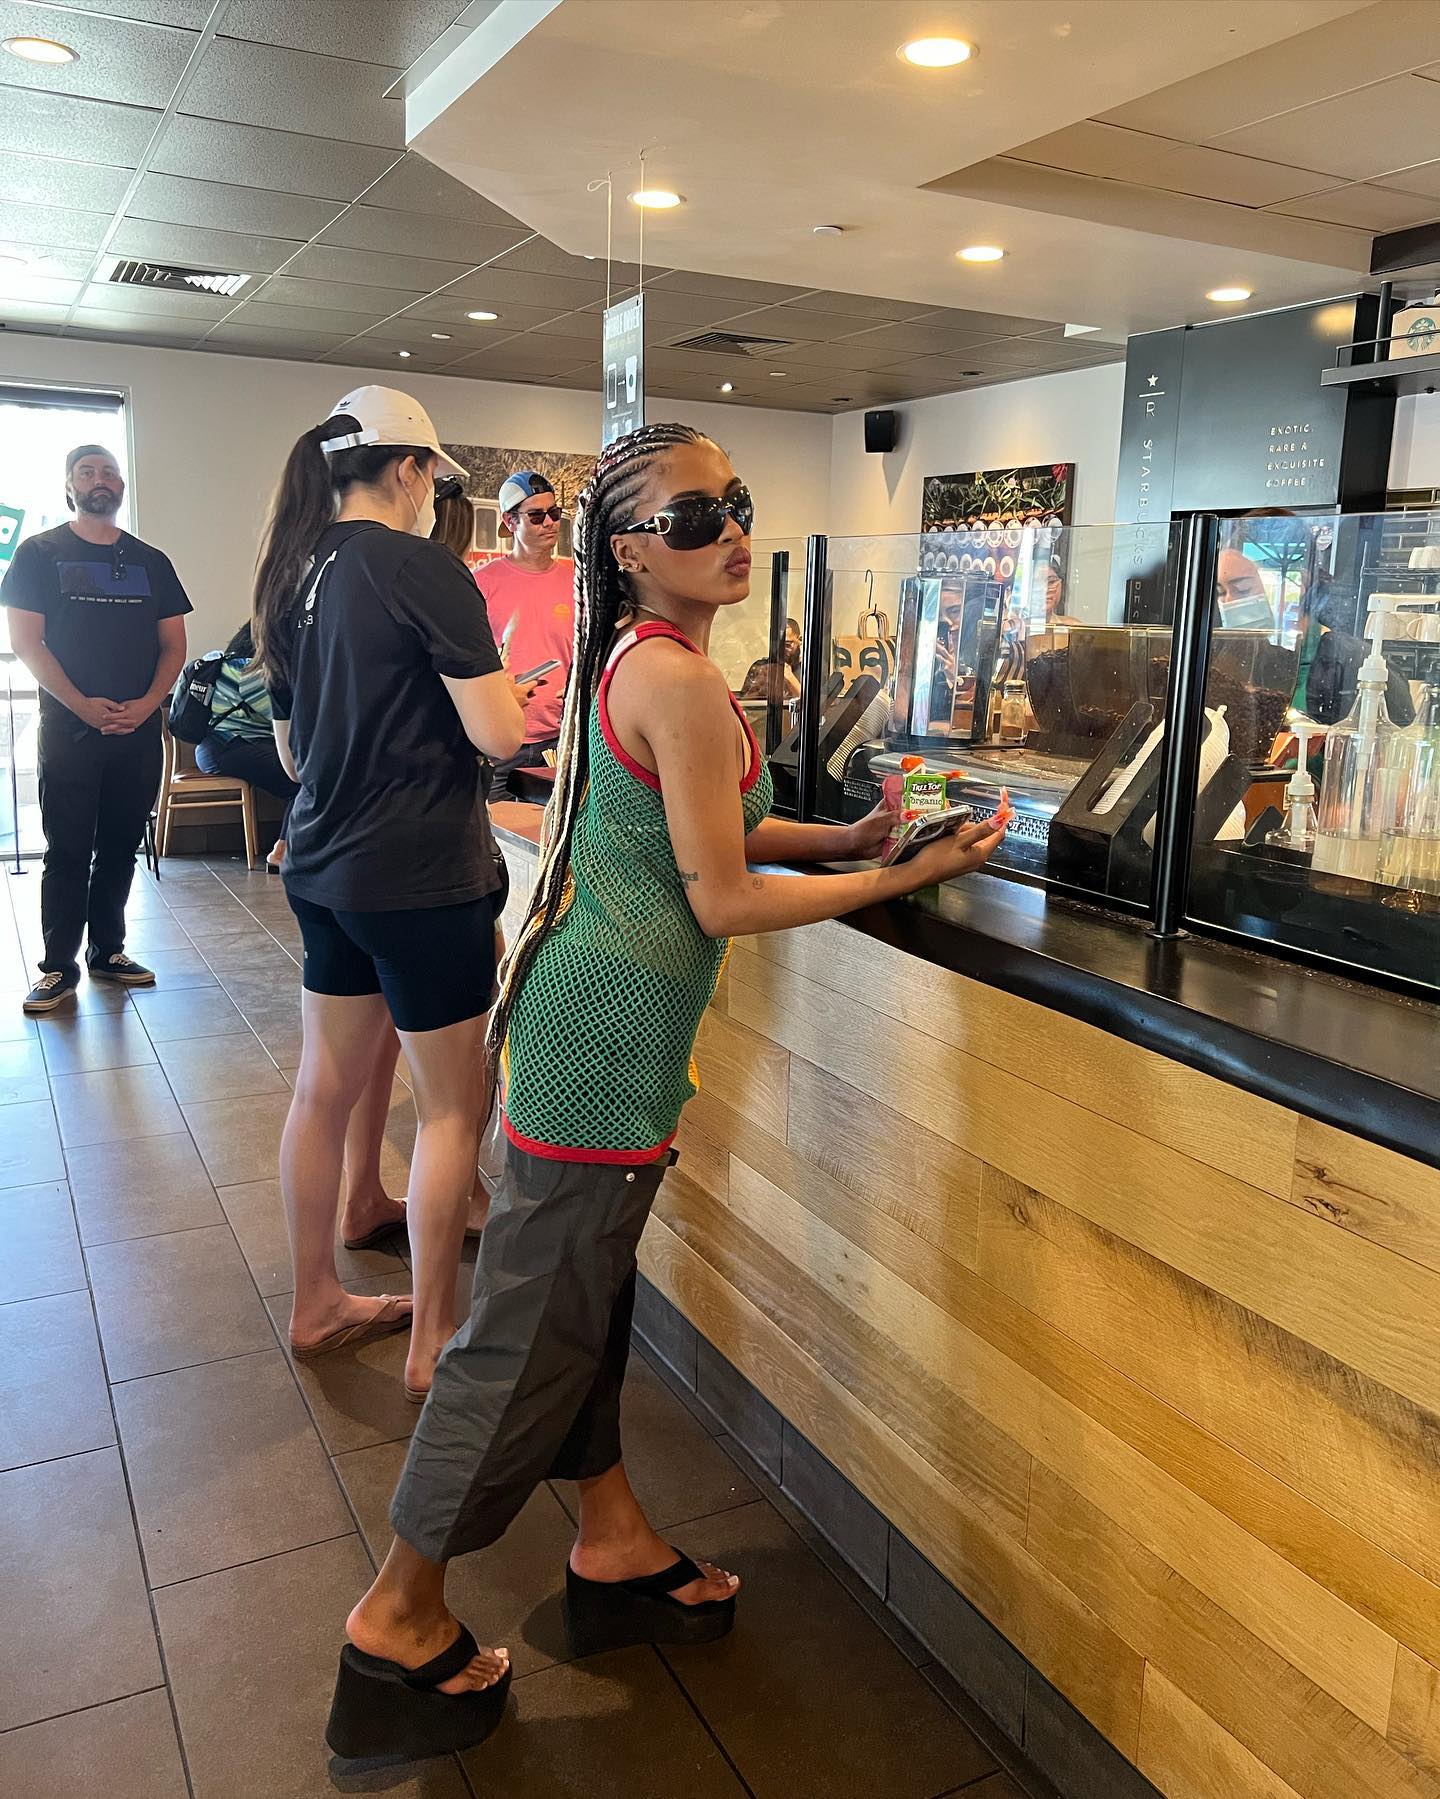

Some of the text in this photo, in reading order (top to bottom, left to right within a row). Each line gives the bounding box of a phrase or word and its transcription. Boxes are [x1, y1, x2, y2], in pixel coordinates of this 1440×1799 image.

[1269, 443, 1296, 453] RARE
[1267, 458, 1325, 471] EXQUISITE
[1265, 477, 1306, 488] COFFEE
[1133, 439, 1153, 565] STARBUCKS
[911, 782, 942, 792] TREE TOP
